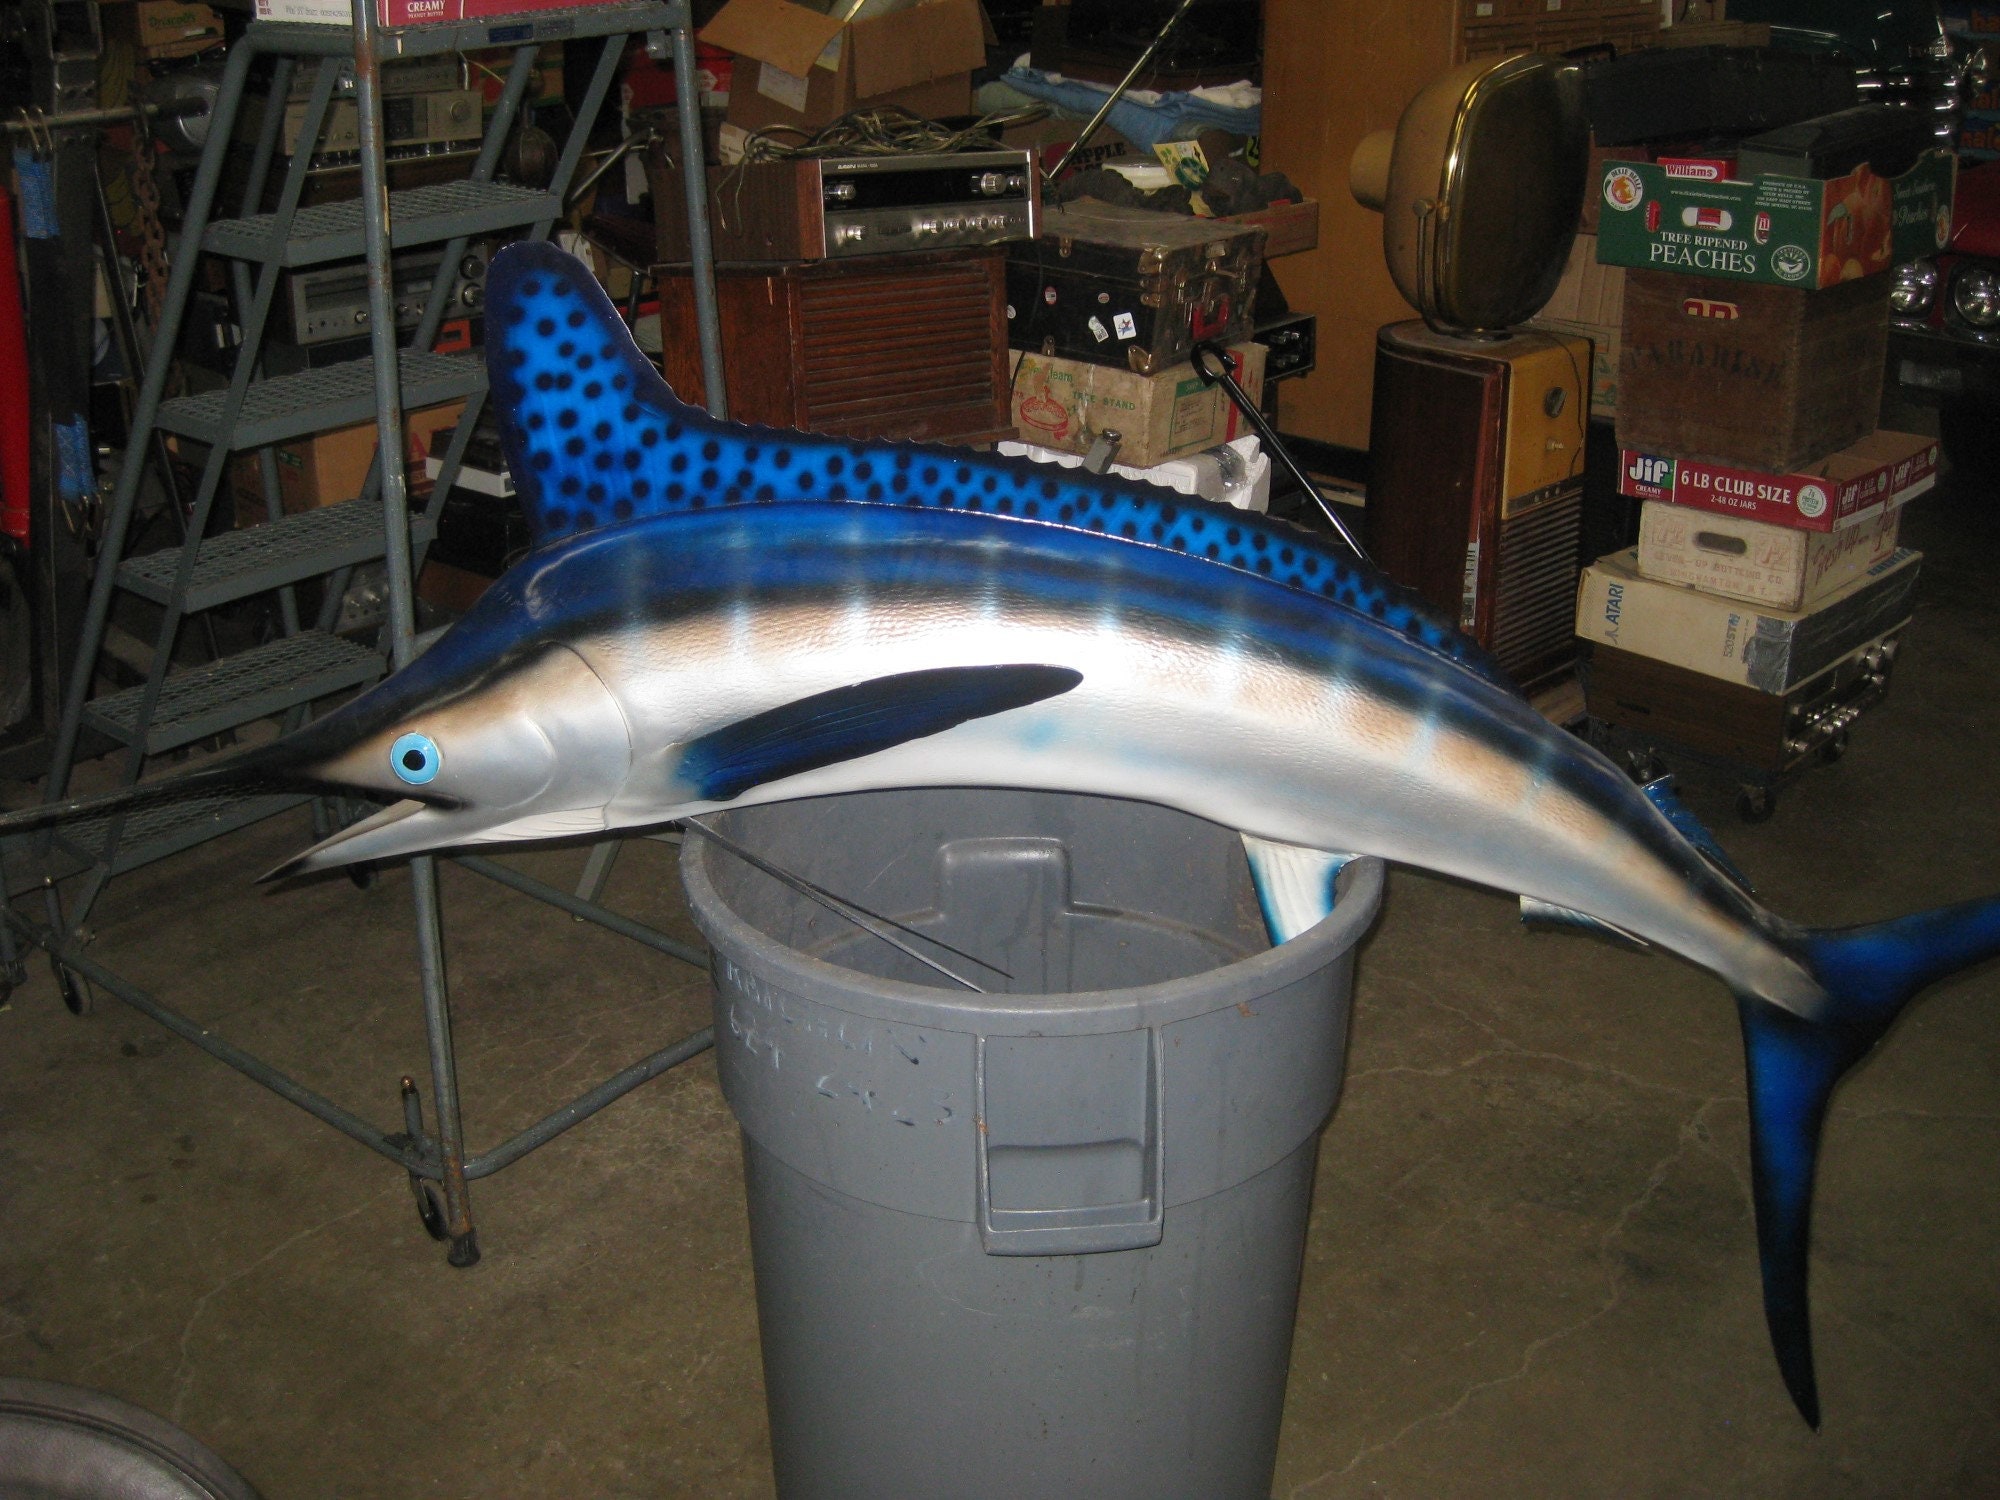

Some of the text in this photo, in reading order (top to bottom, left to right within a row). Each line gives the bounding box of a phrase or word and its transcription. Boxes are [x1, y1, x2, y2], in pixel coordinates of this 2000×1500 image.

[407, 1, 445, 12] CREAMY
[1667, 164, 1714, 178] Williams
[1660, 231, 1748, 251] TREE RIPENED
[1649, 242, 1756, 274] PEACHES
[1629, 456, 1670, 484] Jif
[1635, 484, 1662, 496] CREAMY
[1681, 470, 1791, 505] 6 LB CLUB SIZE
[1710, 494, 1757, 511] 2-48 OZ JARS
[1605, 582, 1624, 626] ATARI
